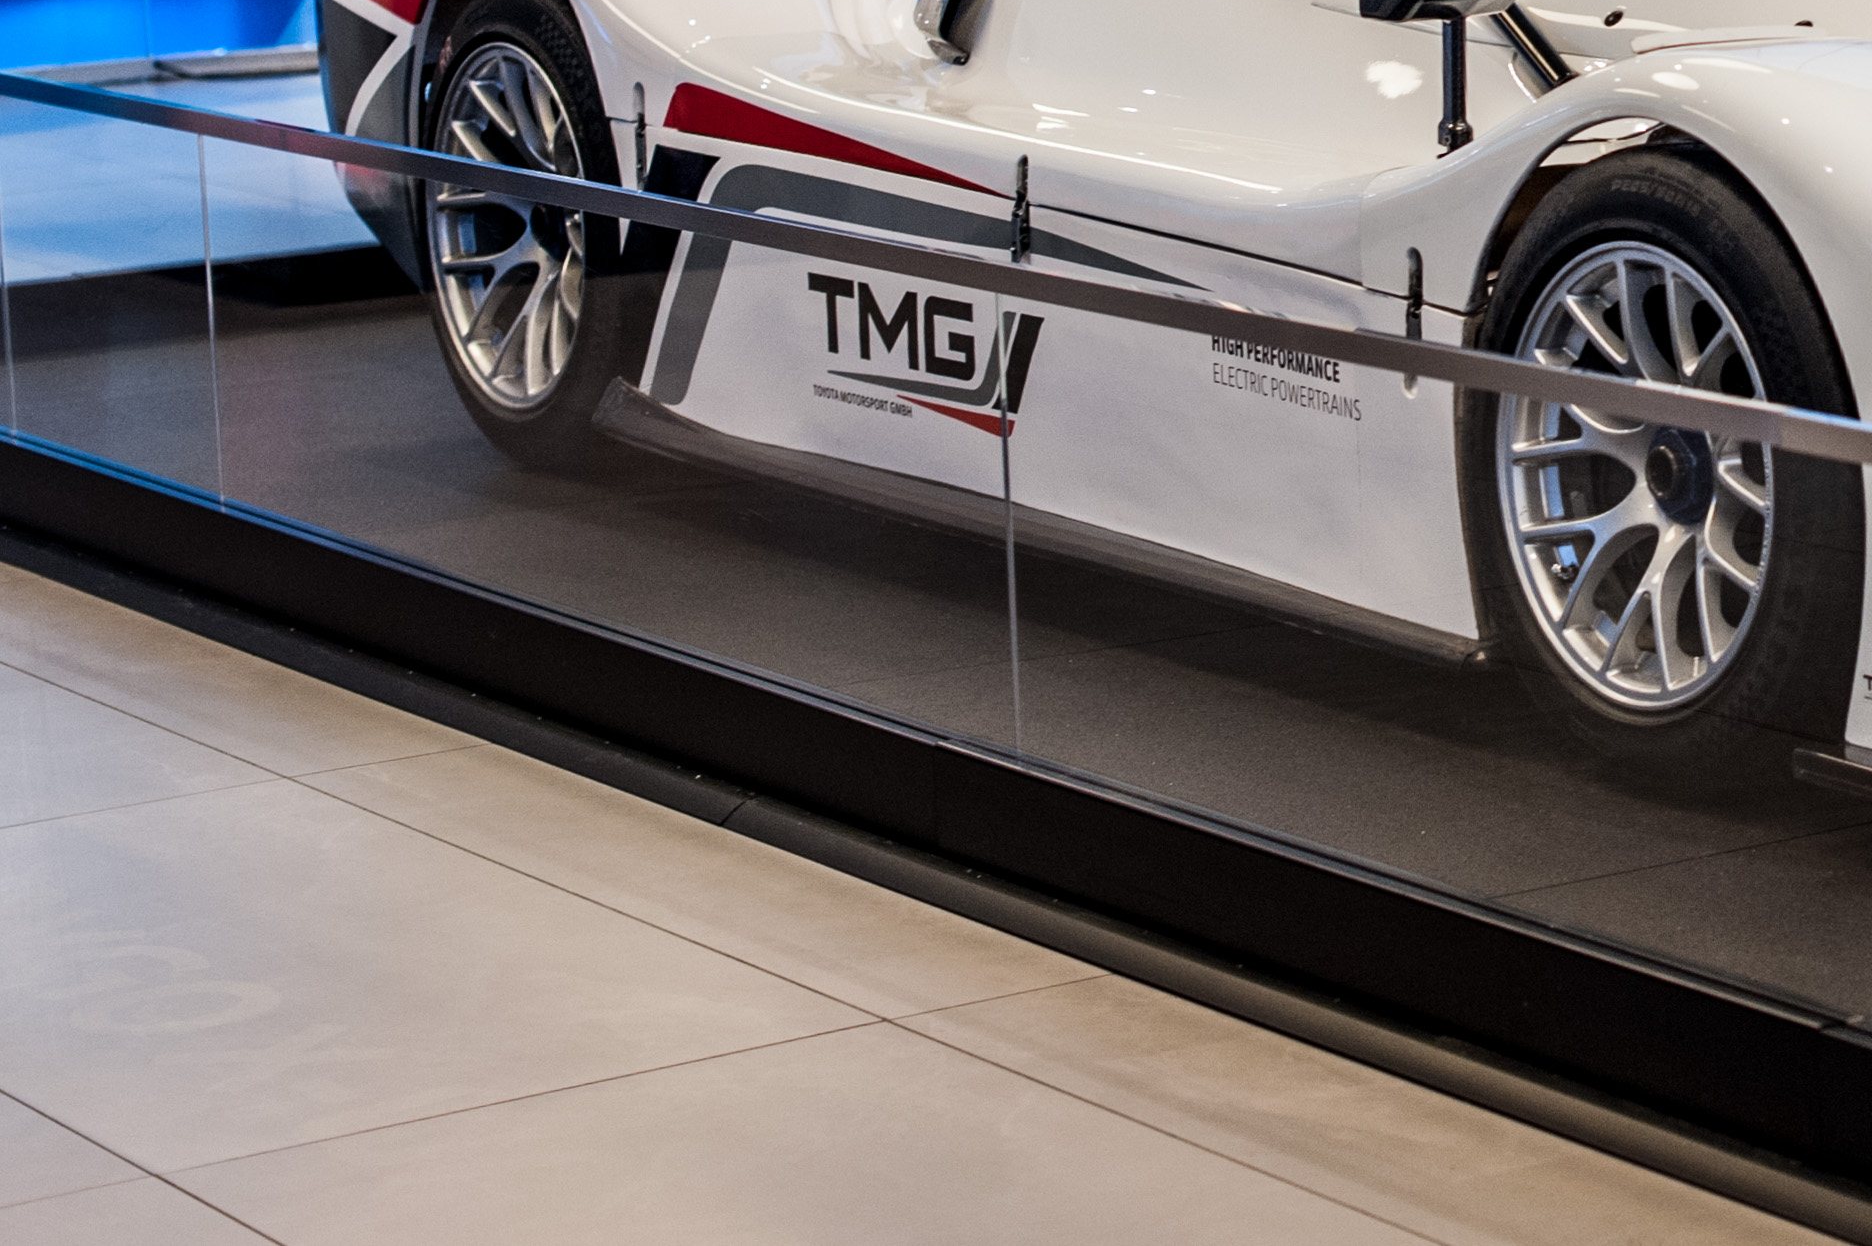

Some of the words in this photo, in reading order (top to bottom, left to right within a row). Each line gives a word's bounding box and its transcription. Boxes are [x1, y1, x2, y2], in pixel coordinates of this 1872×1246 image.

[1211, 334, 1244, 358] HIGH
[1246, 342, 1341, 383] PERFORMANCE
[813, 384, 839, 400] TOYOTA
[840, 391, 889, 412] MOTORSPORT
[1212, 362, 1268, 397] ELECTRIC
[1270, 377, 1362, 421] POWERTRAINS
